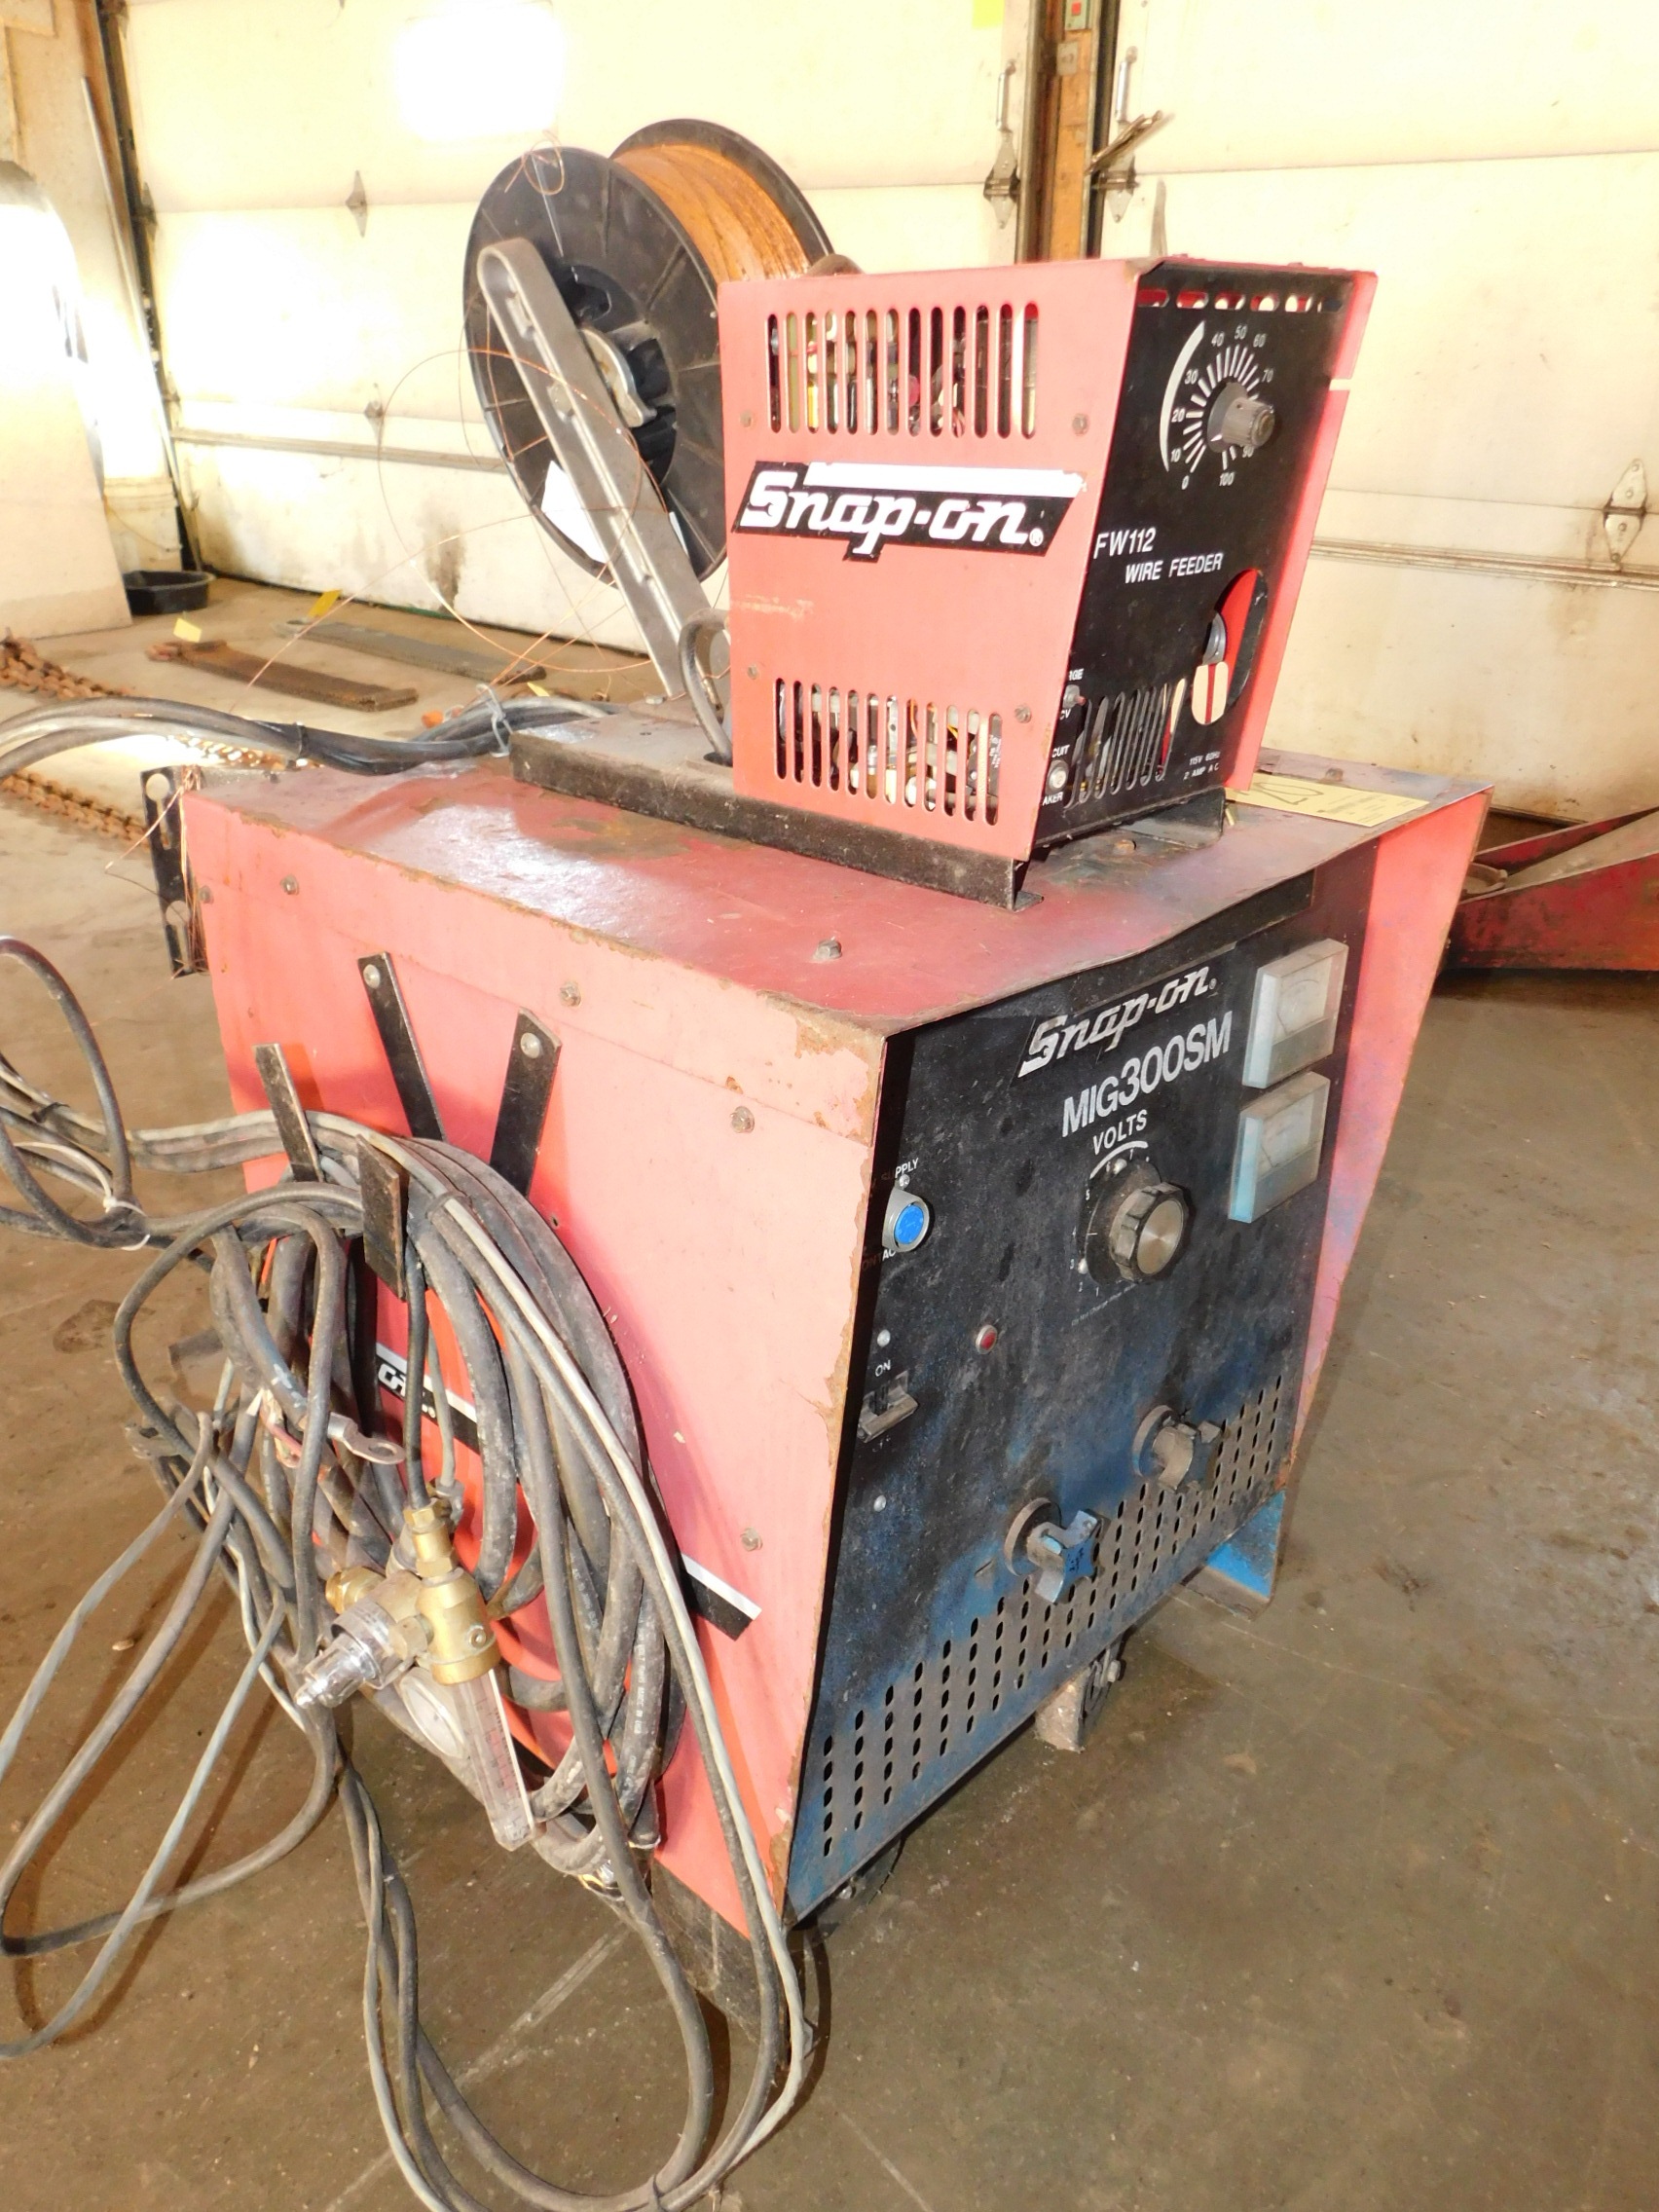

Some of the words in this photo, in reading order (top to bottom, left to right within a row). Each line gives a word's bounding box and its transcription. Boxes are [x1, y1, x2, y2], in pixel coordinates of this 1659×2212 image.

[1212, 333, 1224, 346] 40
[1235, 325, 1247, 339] 50
[1253, 334, 1266, 348] 60
[1185, 369, 1198, 385] 30
[1262, 369, 1273, 383] 70
[1172, 409, 1185, 422] 20
[1170, 450, 1181, 462] 10
[1181, 474, 1189, 490] 0
[1219, 471, 1235, 486] 100
[1093, 527, 1157, 559] FW112
[1124, 560, 1163, 583] WIRE
[1168, 552, 1224, 577] FEEDER
[1192, 766, 1206, 777] AMP
[1062, 1011, 1233, 1138] MIG300SM
[1092, 1109, 1148, 1155] VOLTS
[875, 1359, 892, 1377] ON
